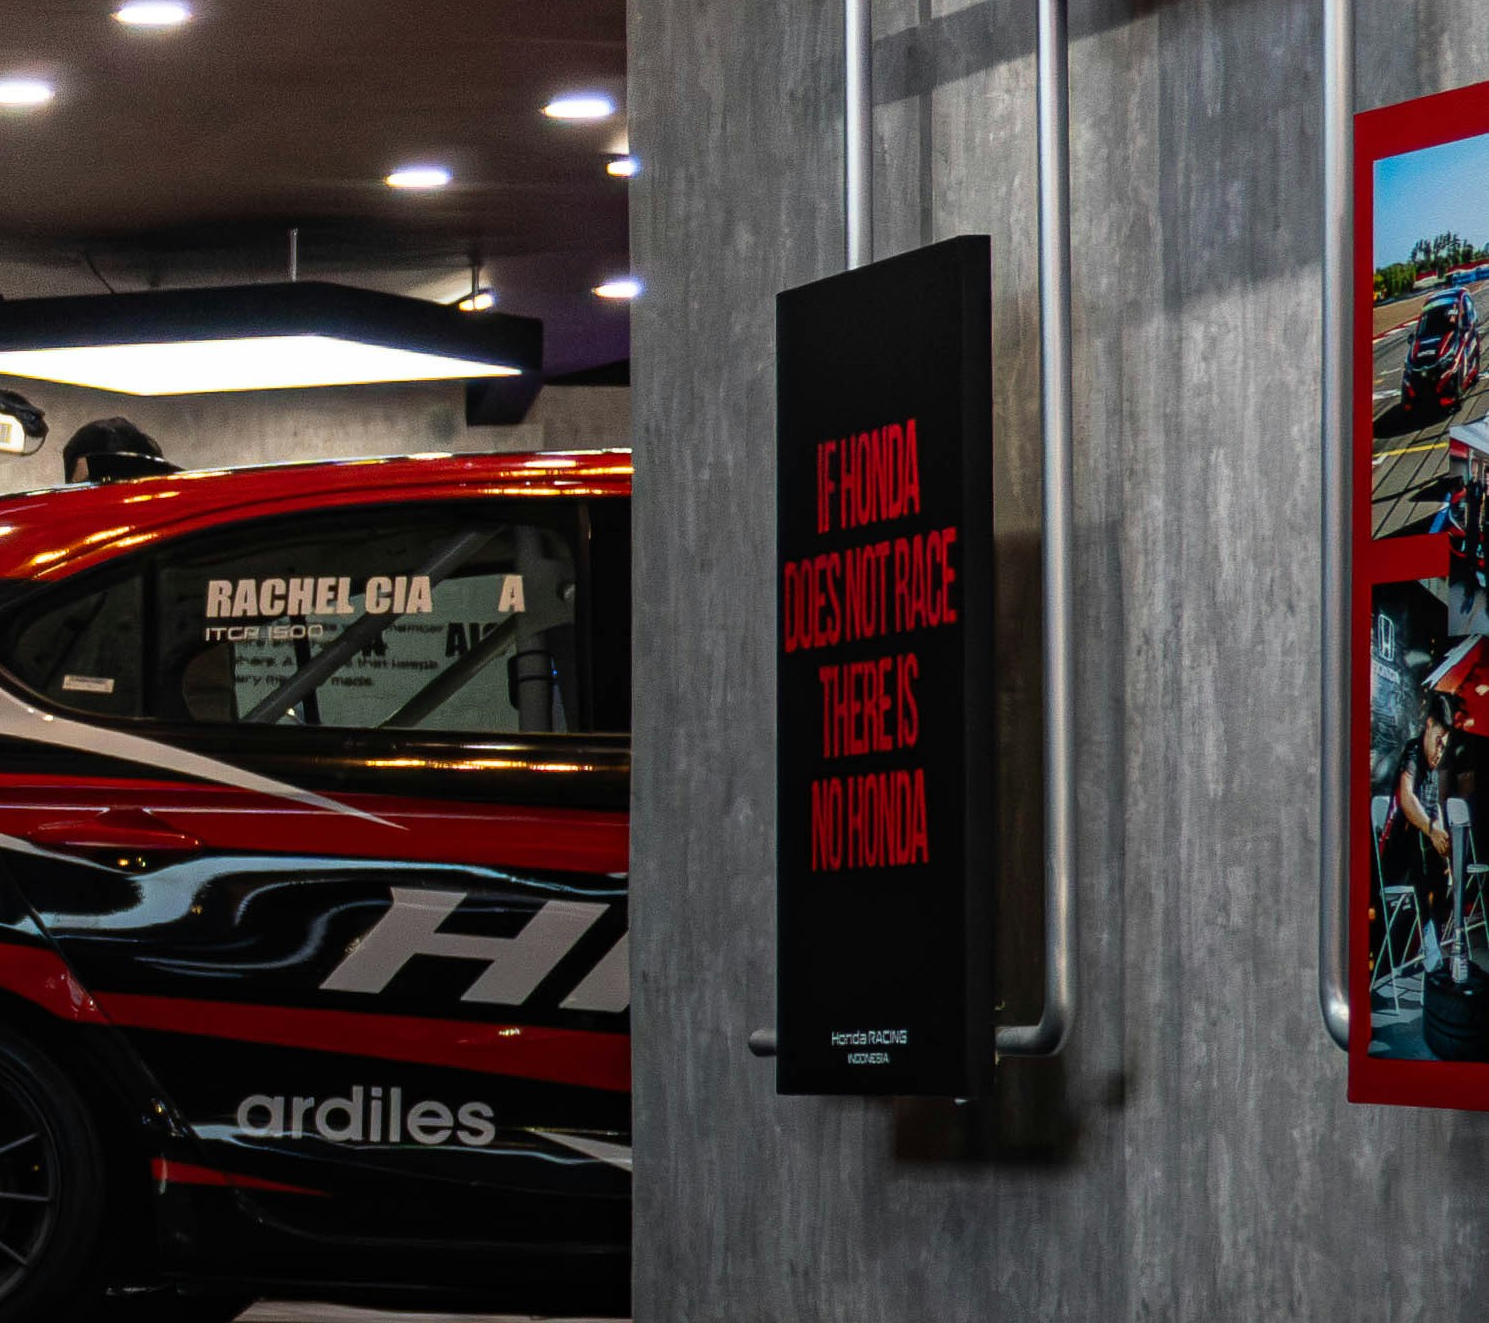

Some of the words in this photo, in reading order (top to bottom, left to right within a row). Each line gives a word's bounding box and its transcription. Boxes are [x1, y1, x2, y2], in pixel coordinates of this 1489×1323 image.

[816, 440, 836, 534] IF
[840, 418, 921, 529] HONDA
[206, 577, 355, 618] RACHEL
[364, 575, 433, 614] CIA
[498, 575, 526, 612] A
[783, 551, 841, 653] DOES
[844, 541, 891, 639] NOT
[894, 526, 958, 633] RACE
[268, 624, 324, 640] 1500
[819, 656, 893, 759] THERE
[896, 652, 919, 749] IS
[812, 776, 843, 872] NO
[846, 768, 930, 868] HONDA
[831, 1030, 867, 1046] Honda
[868, 1029, 908, 1044] RACING
[236, 1085, 496, 1147] ardiles
